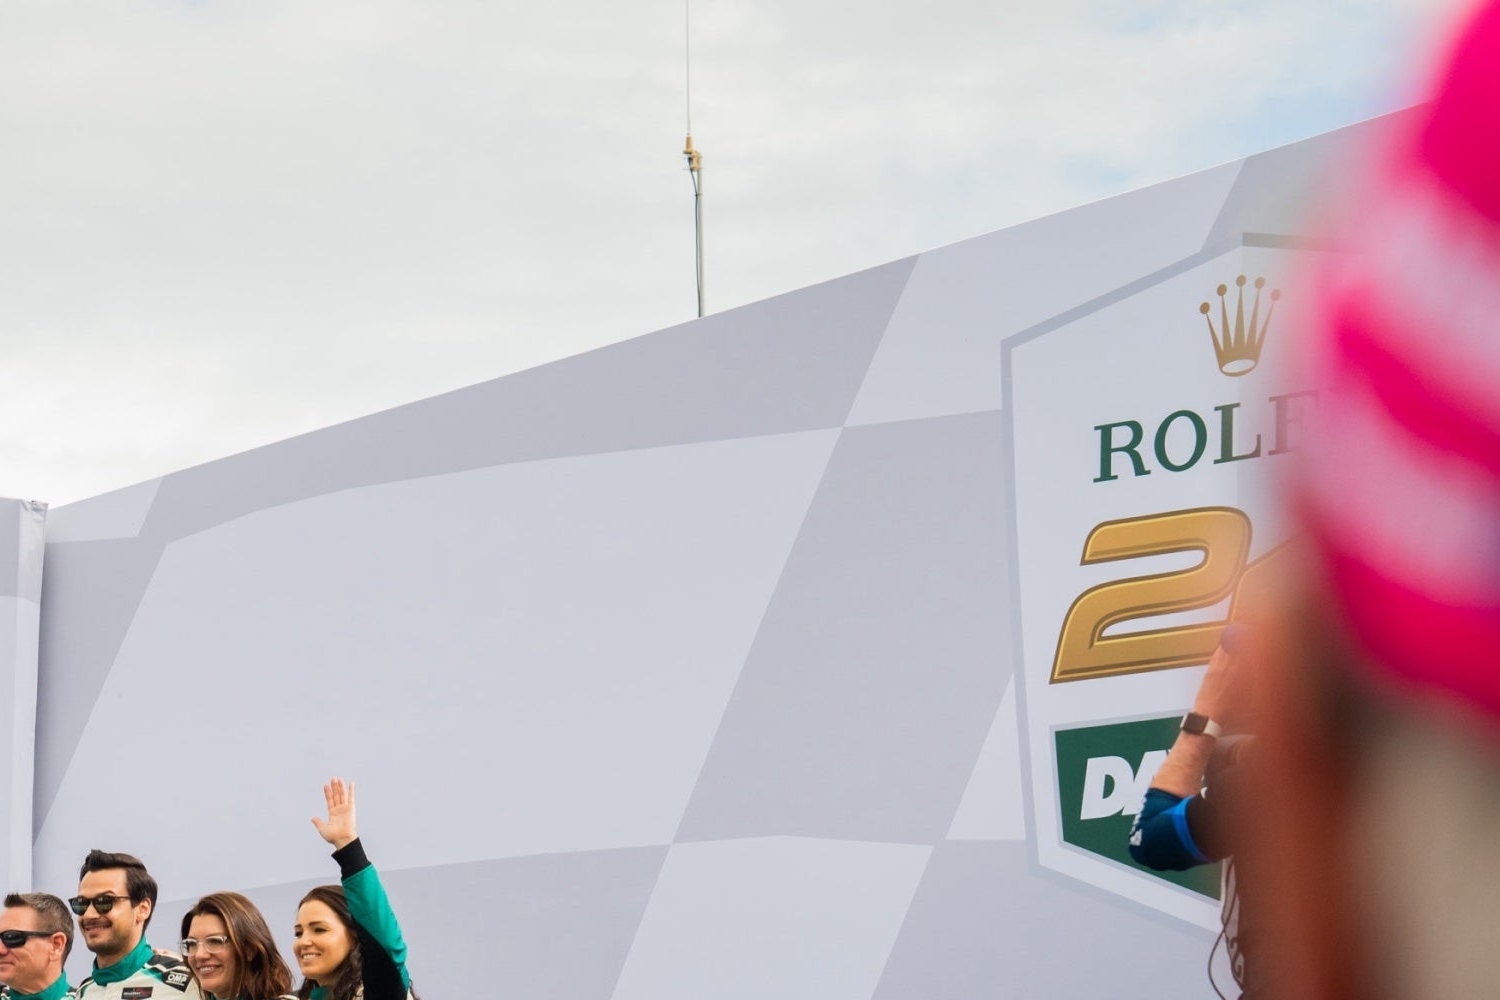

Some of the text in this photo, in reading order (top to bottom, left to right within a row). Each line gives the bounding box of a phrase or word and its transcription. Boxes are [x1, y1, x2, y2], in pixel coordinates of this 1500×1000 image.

[1093, 390, 1318, 483] ROLE
[1049, 505, 1272, 685] 2
[167, 973, 188, 984] OMP
